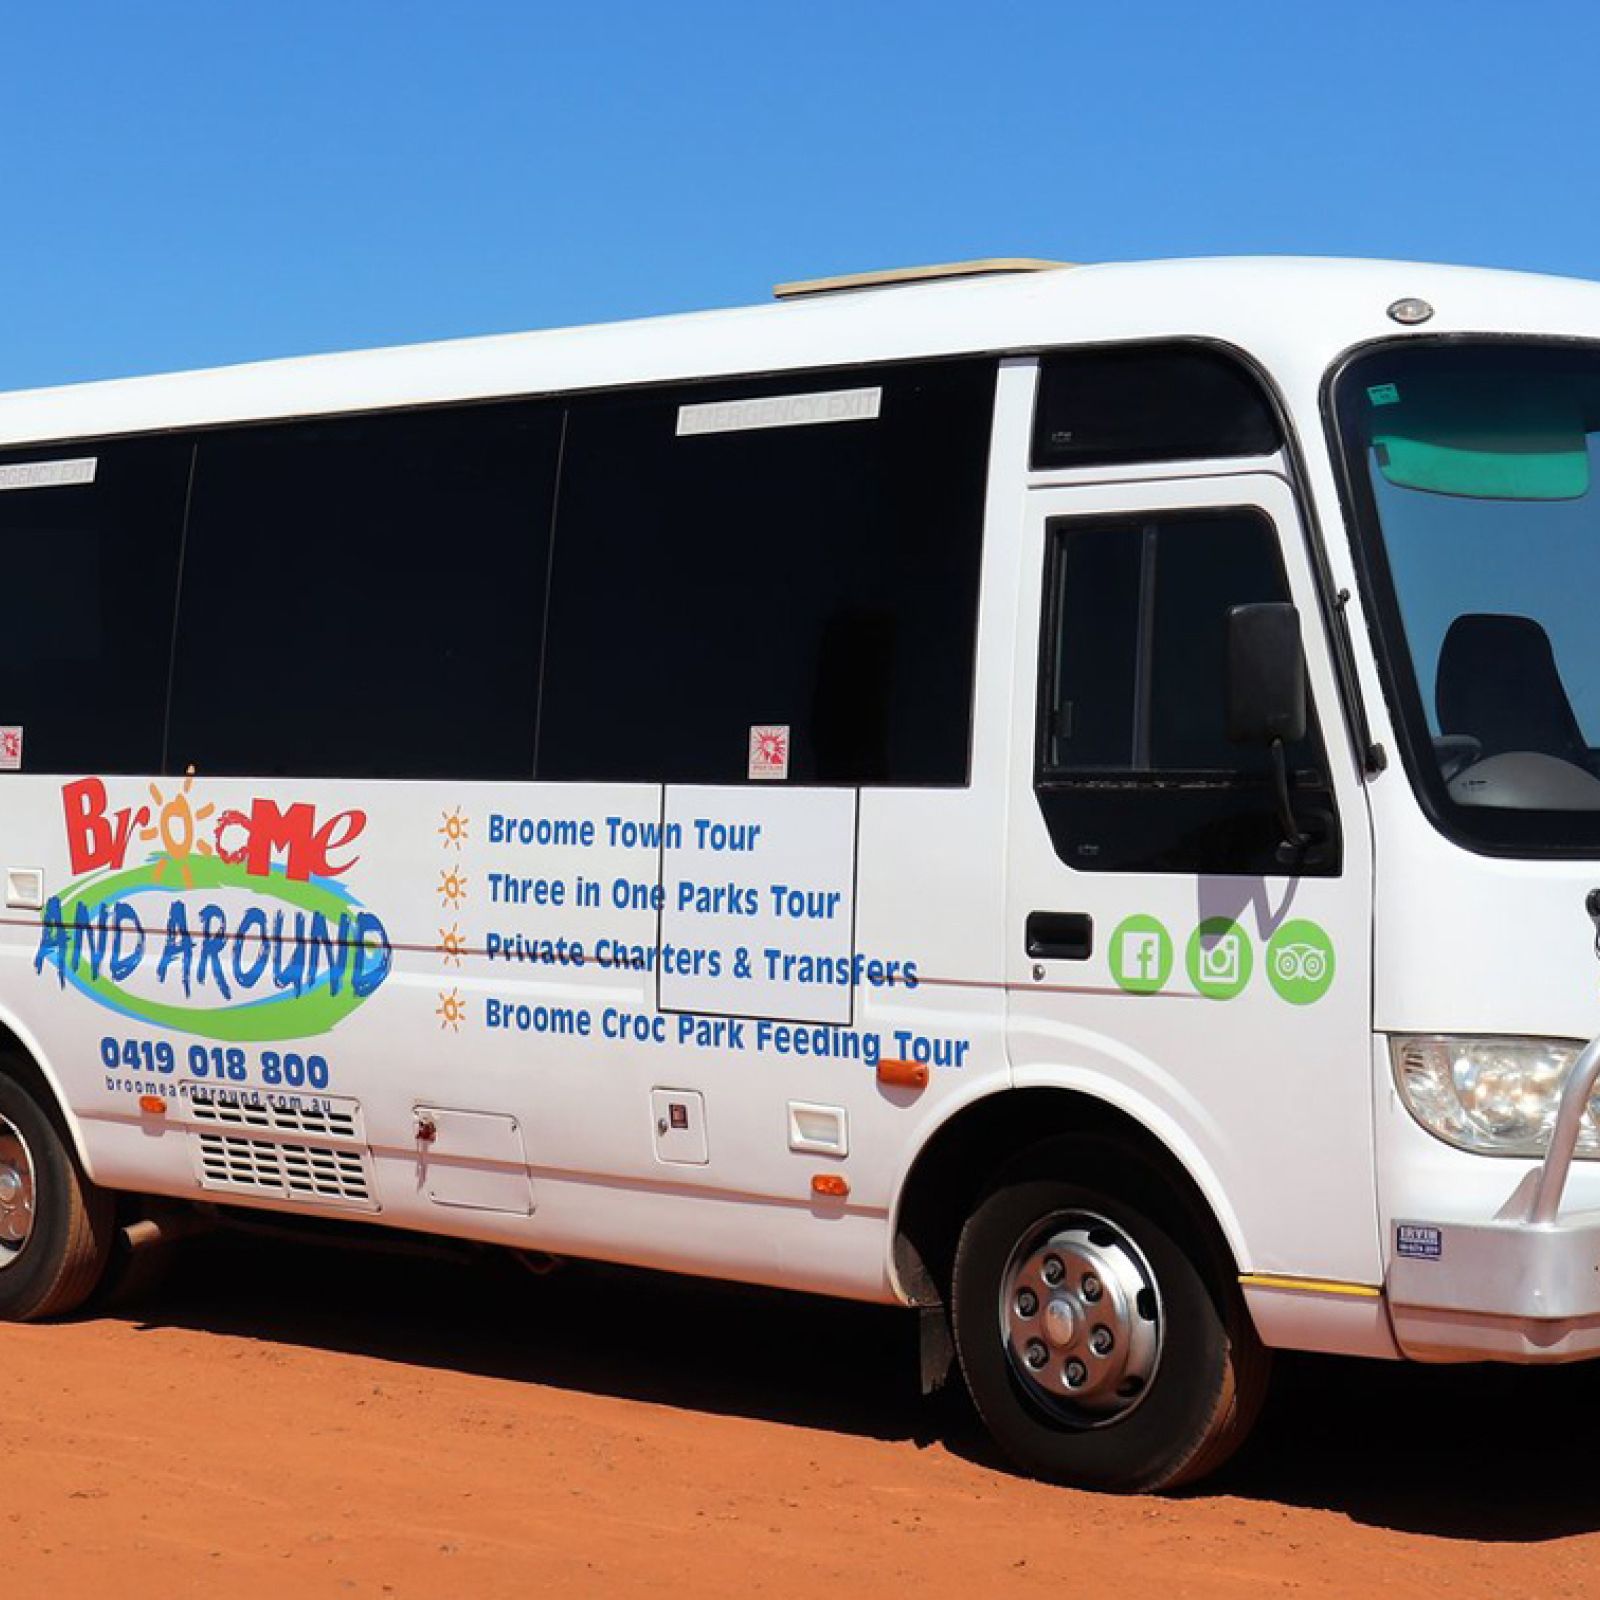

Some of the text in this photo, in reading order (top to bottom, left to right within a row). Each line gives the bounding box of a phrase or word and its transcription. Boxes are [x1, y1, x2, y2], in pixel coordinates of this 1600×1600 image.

[828, 389, 879, 420] EXIT
[488, 814, 762, 851] Broome Town Tour
[488, 873, 842, 920] Three in One Parks Tour
[34, 896, 393, 1000] AND AROUND
[486, 932, 919, 990] Private Charters & Transfers
[486, 998, 969, 1067] Broome Croc Park Feeding Tour
[100, 1036, 329, 1090] 0419 018 800
